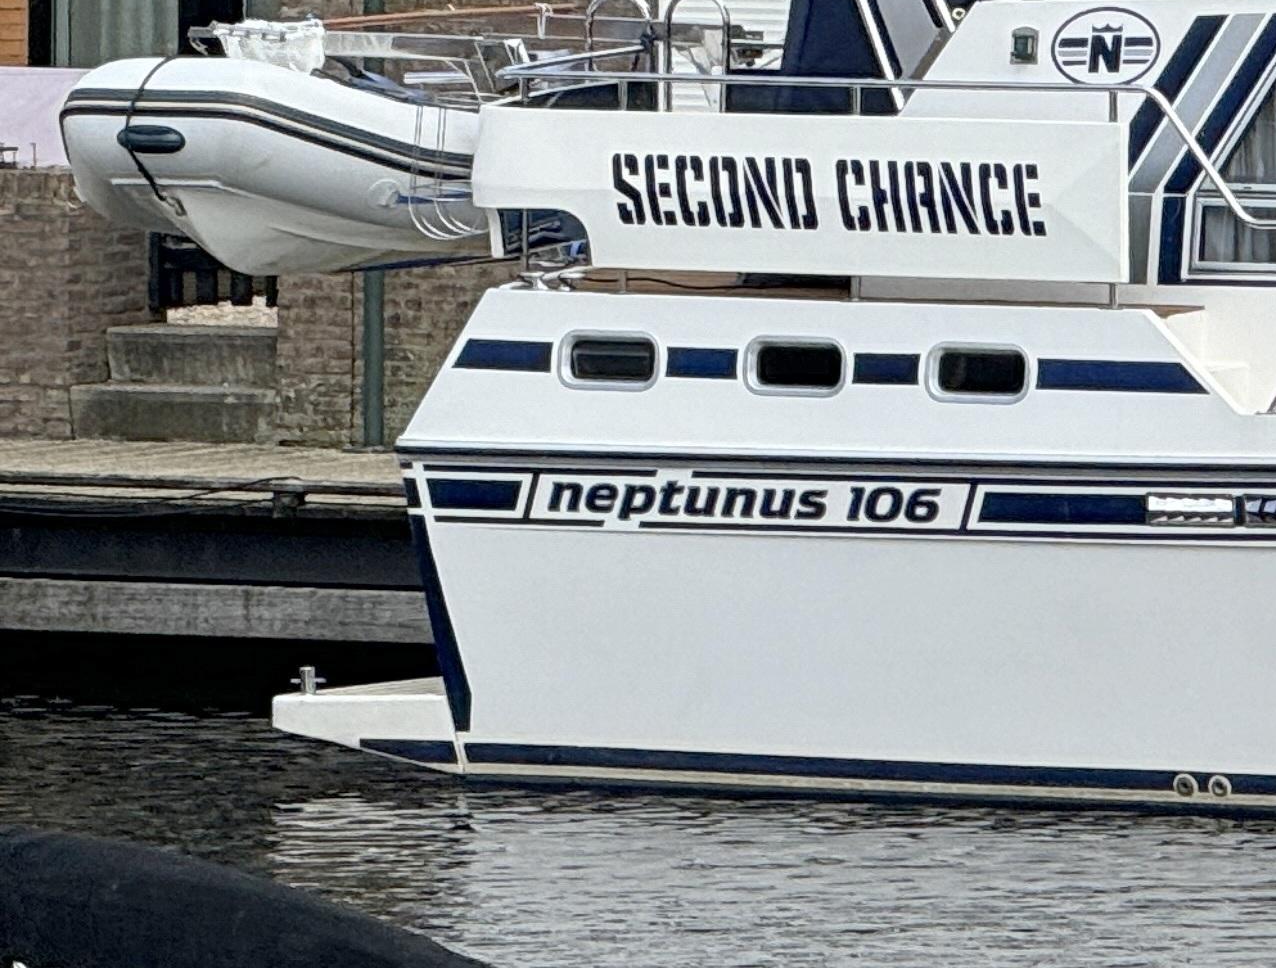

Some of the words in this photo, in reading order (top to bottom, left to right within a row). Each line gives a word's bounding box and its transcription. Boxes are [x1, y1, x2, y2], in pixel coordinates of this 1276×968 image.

[1088, 34, 1122, 73] N
[612, 153, 818, 230] SECOND
[836, 159, 1047, 236] CHANCE
[547, 480, 827, 520] neptunus
[847, 486, 942, 523] 106
